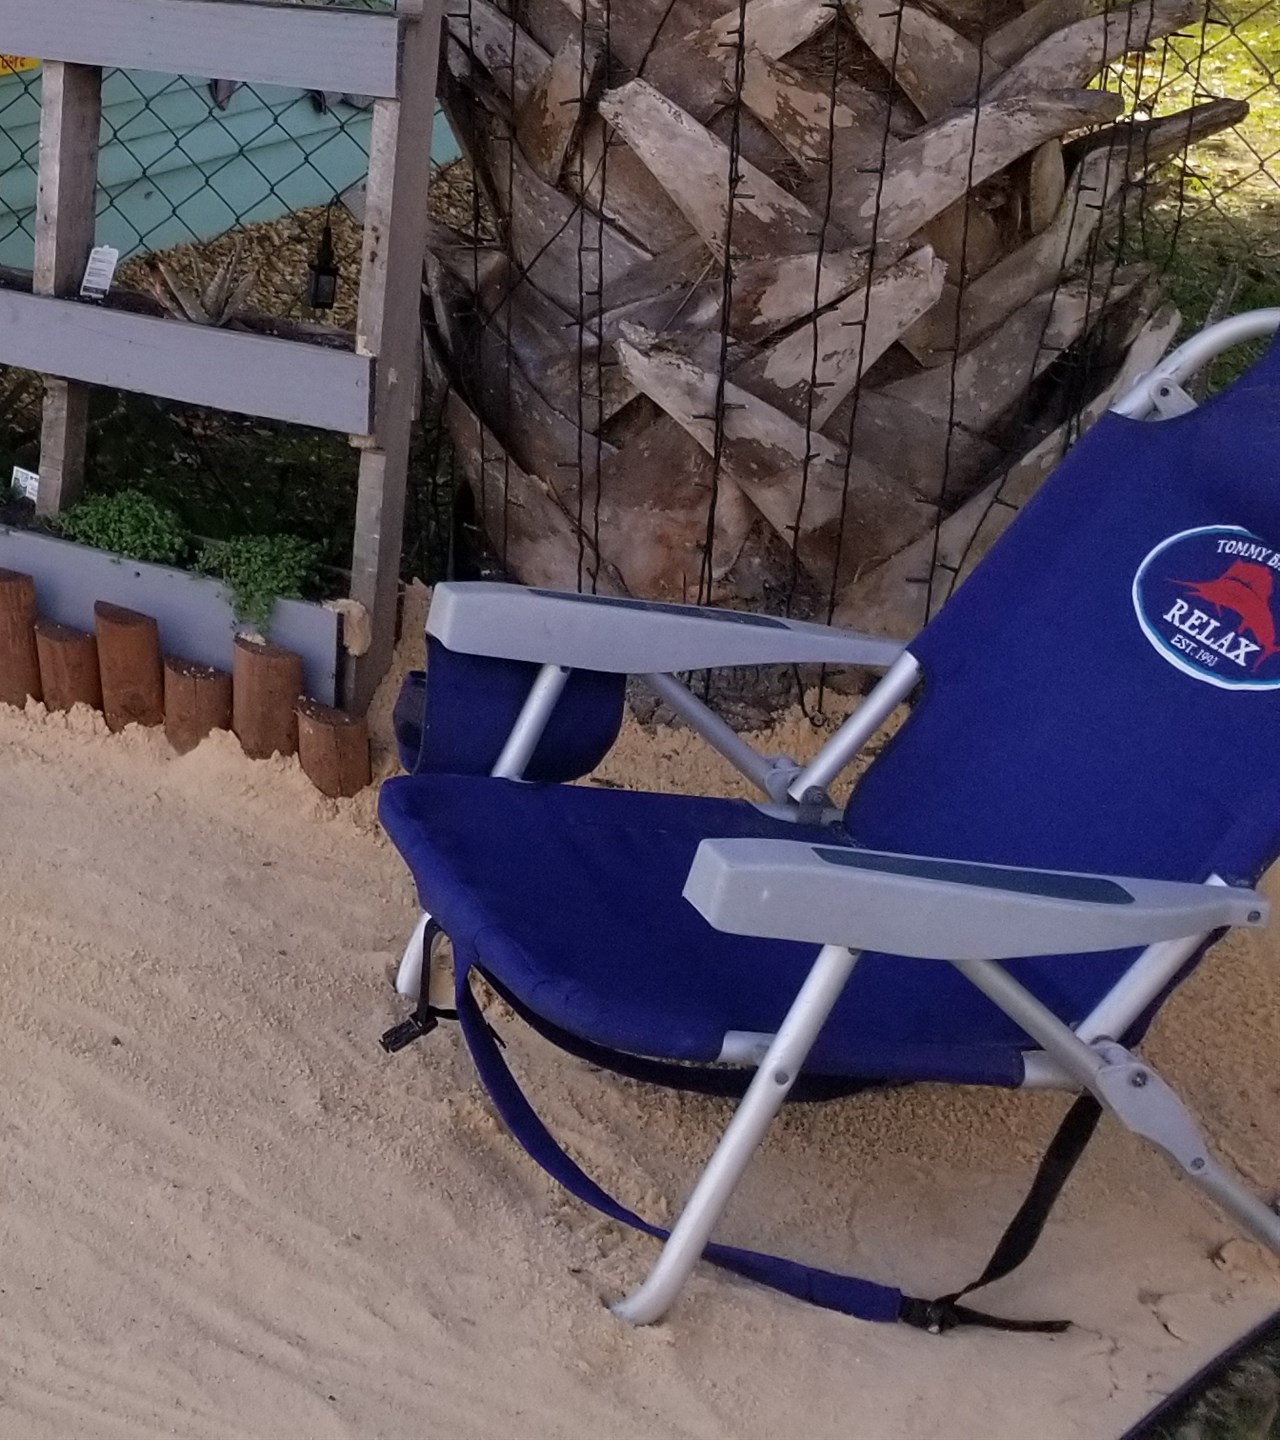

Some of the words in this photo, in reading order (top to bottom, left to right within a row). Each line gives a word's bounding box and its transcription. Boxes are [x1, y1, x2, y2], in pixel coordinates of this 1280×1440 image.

[1215, 539, 1272, 563] TOMMY
[1162, 597, 1262, 668] RELAX
[1169, 633, 1199, 658] EST.
